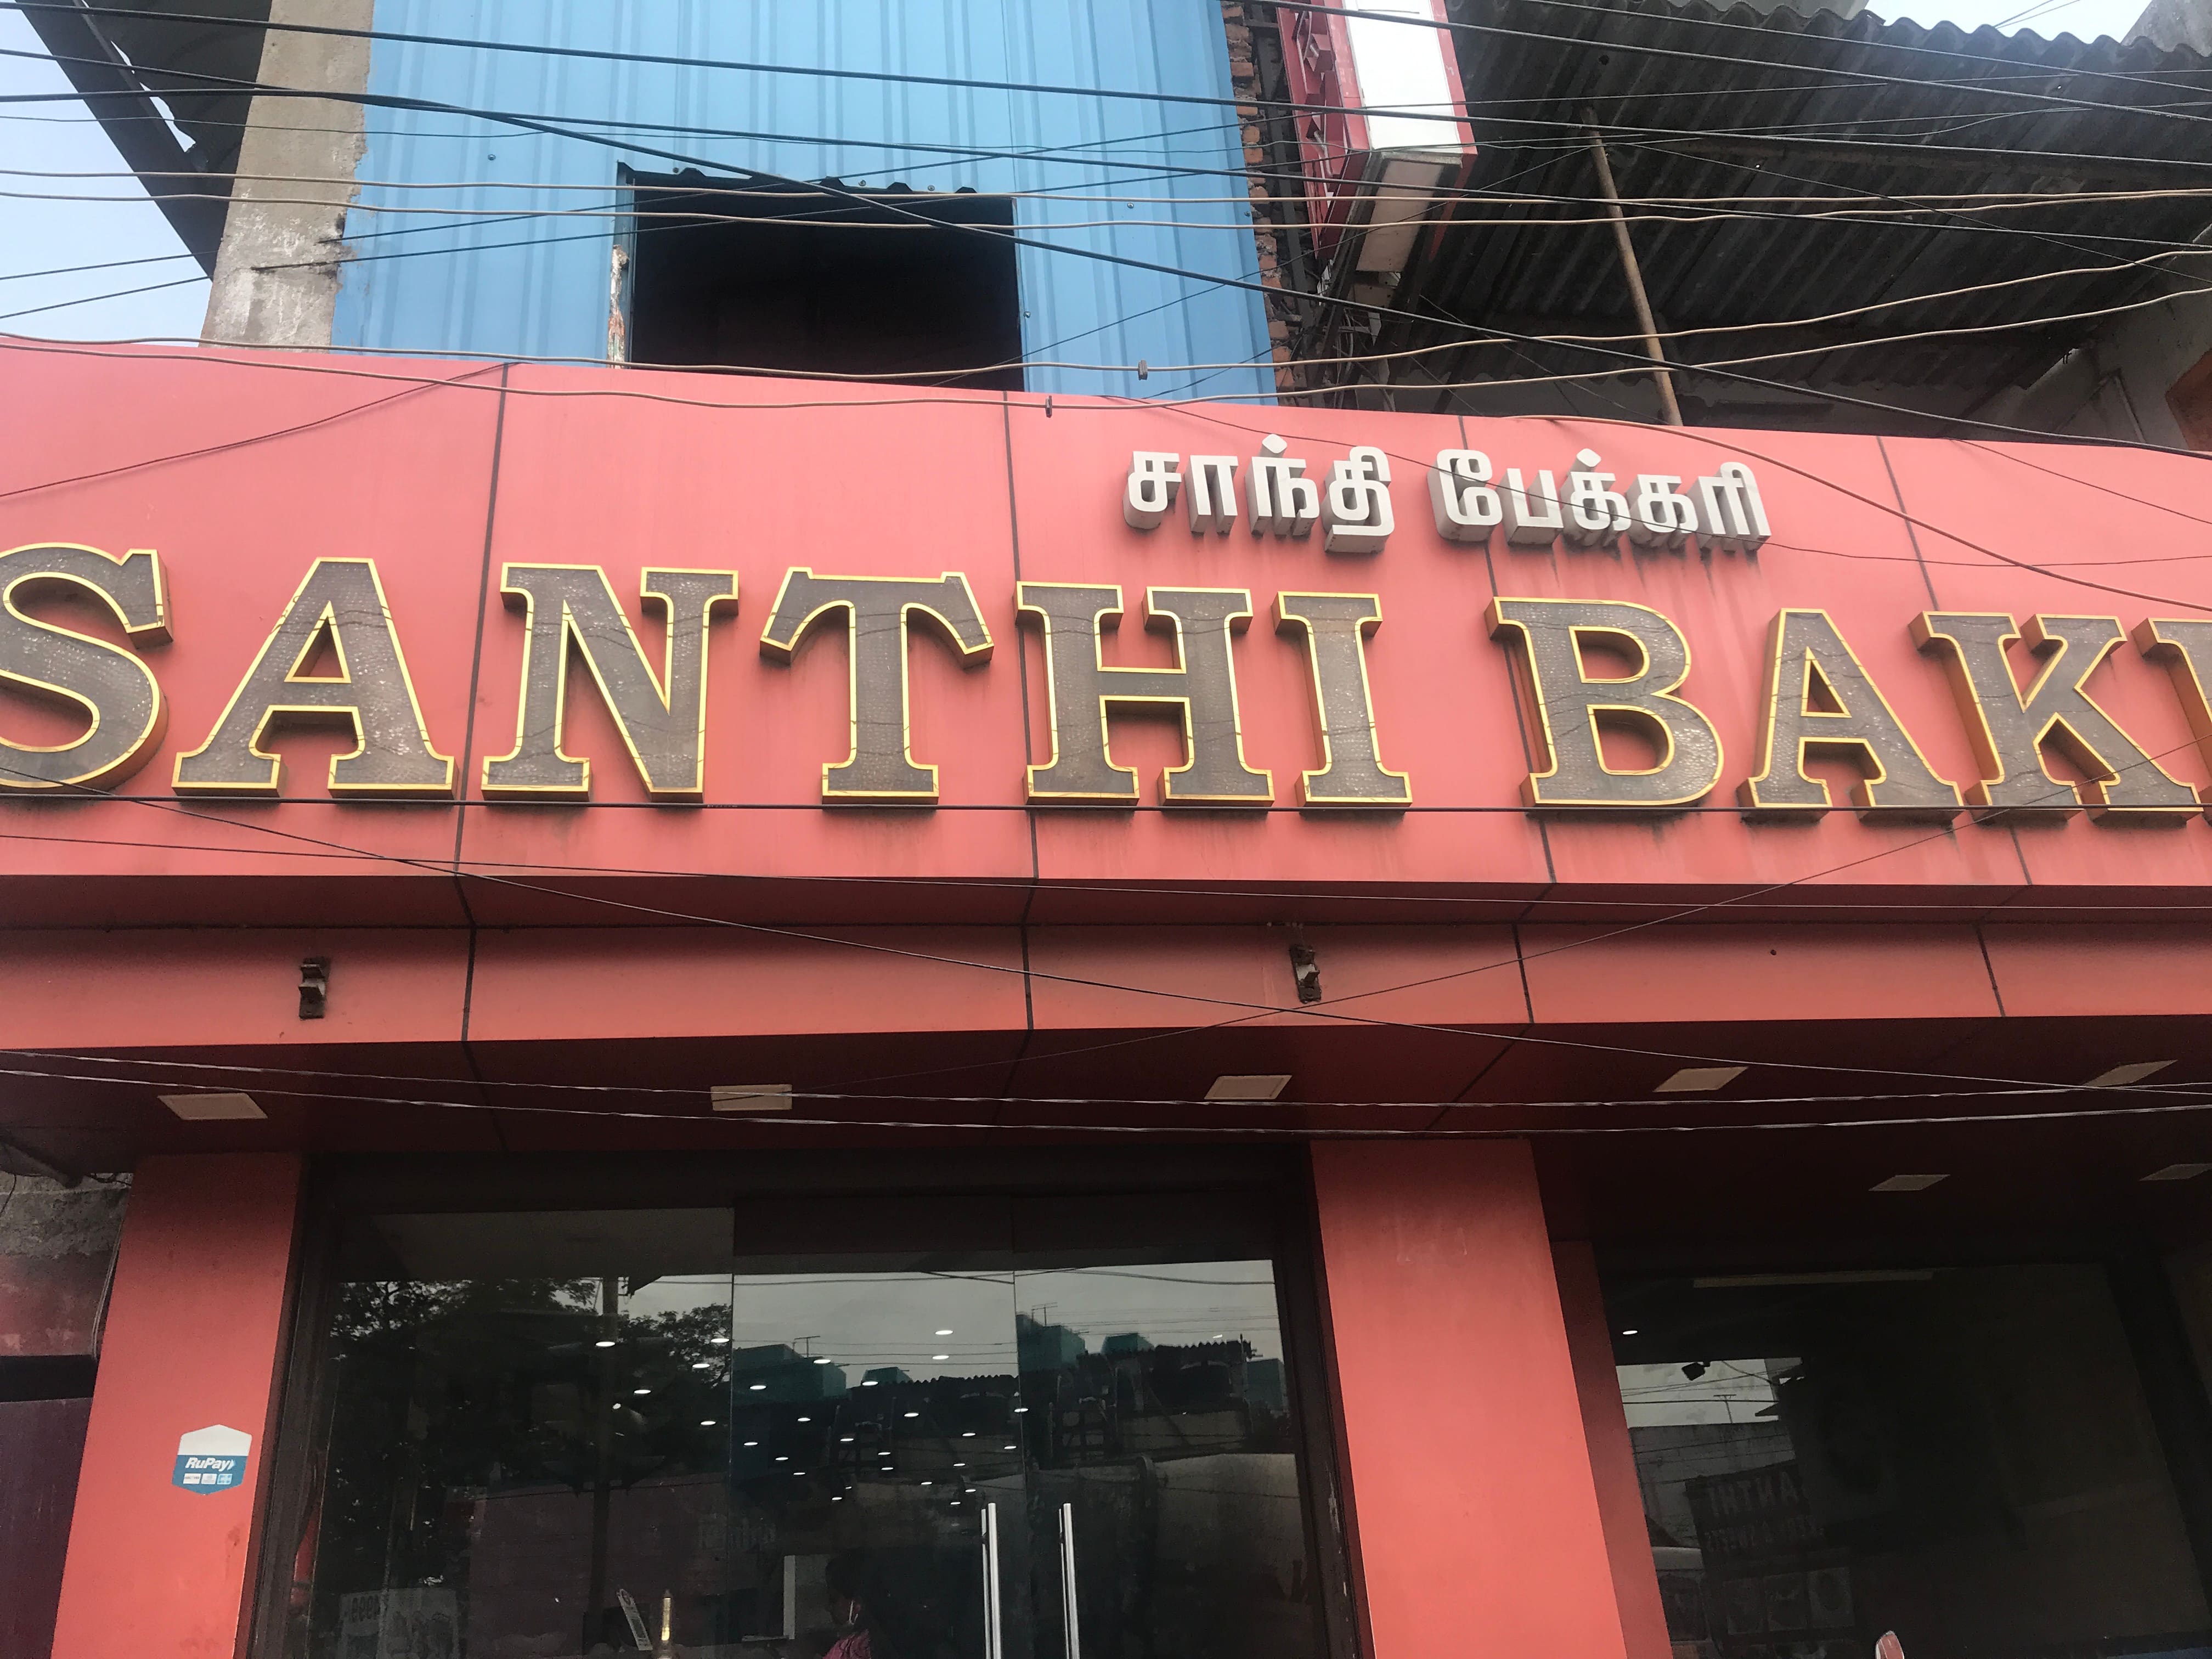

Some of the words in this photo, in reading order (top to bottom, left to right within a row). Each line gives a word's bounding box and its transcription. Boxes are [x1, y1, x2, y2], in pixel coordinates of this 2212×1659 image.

[1125, 433, 1392, 544] சாந்தி
[1429, 448, 1772, 544] பேக்கரி
[0, 541, 1413, 806] SANTHI
[185, 1457, 230, 1472] RuPay
